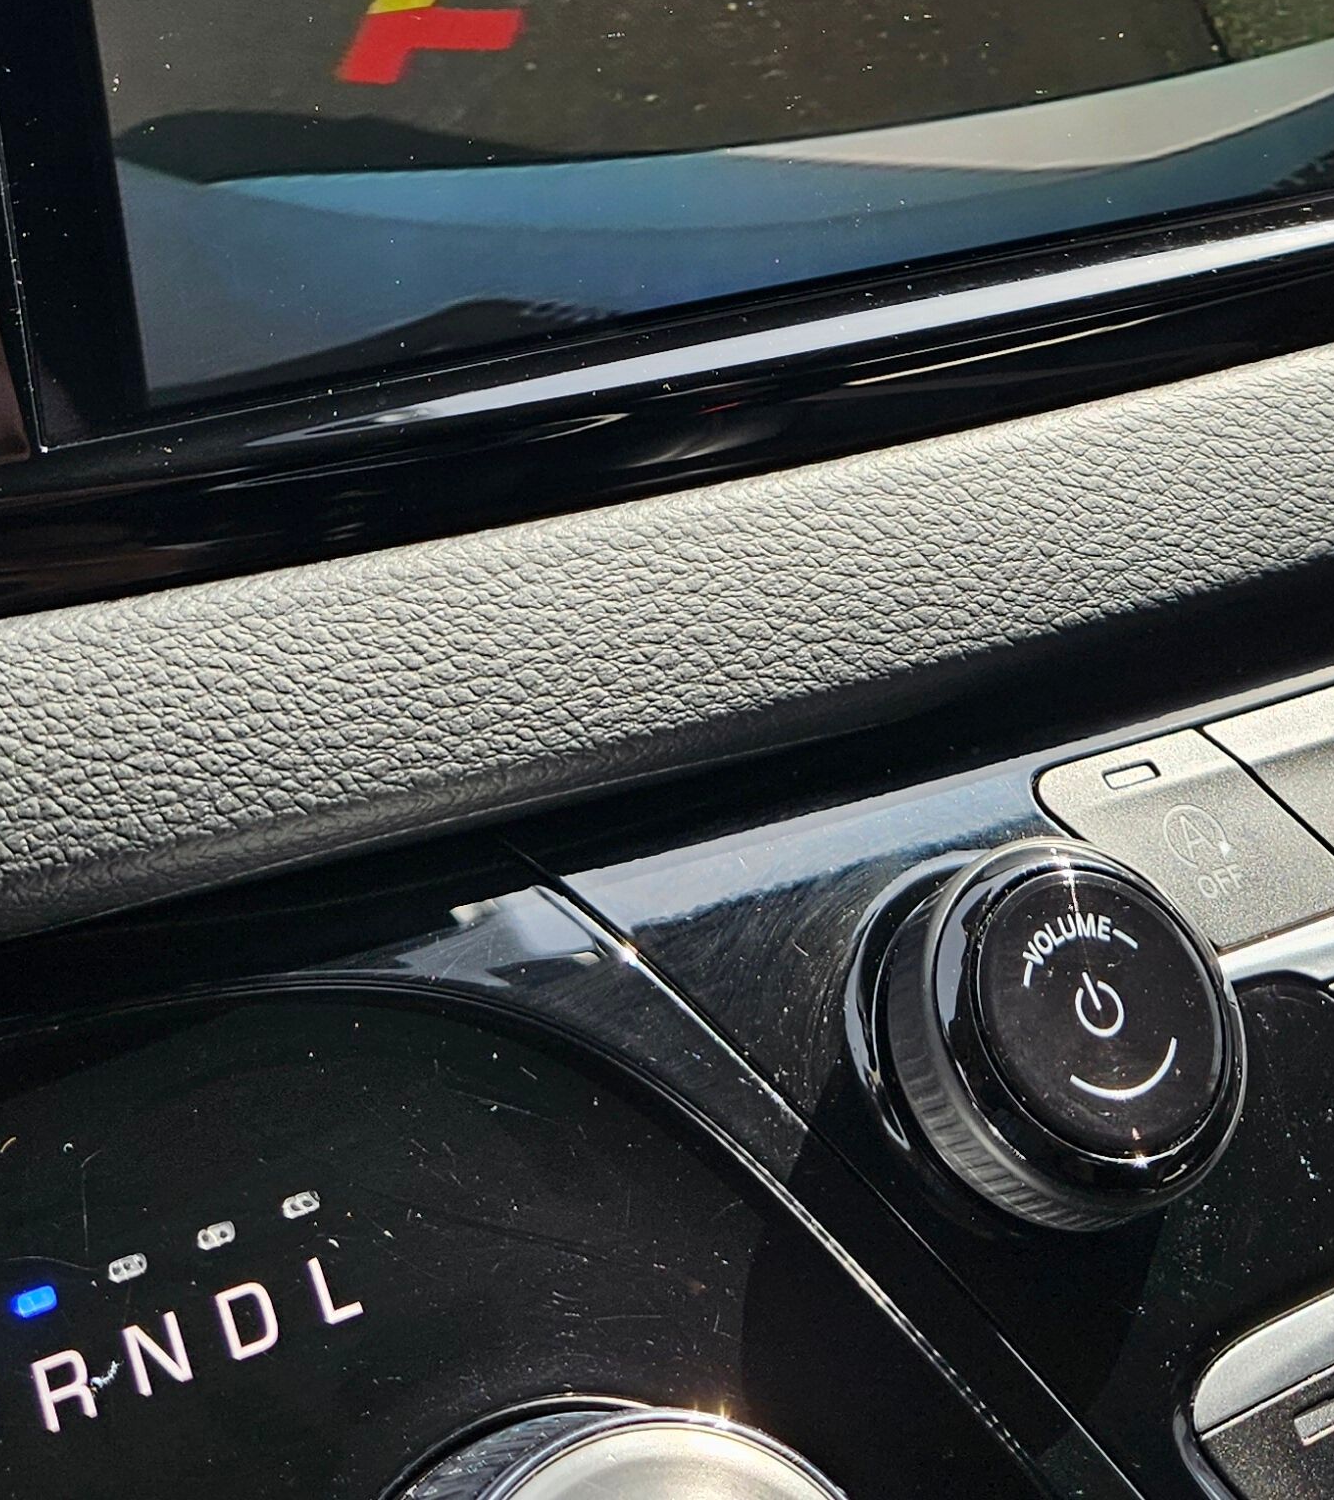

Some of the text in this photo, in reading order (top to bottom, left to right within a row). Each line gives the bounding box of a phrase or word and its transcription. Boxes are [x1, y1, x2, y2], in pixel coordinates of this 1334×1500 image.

[1197, 863, 1245, 900] OFF
[1022, 912, 1112, 967] VOLUME
[30, 1348, 99, 1434] R
[121, 1310, 194, 1398] N
[214, 1281, 280, 1362] D
[305, 1256, 365, 1326] L
